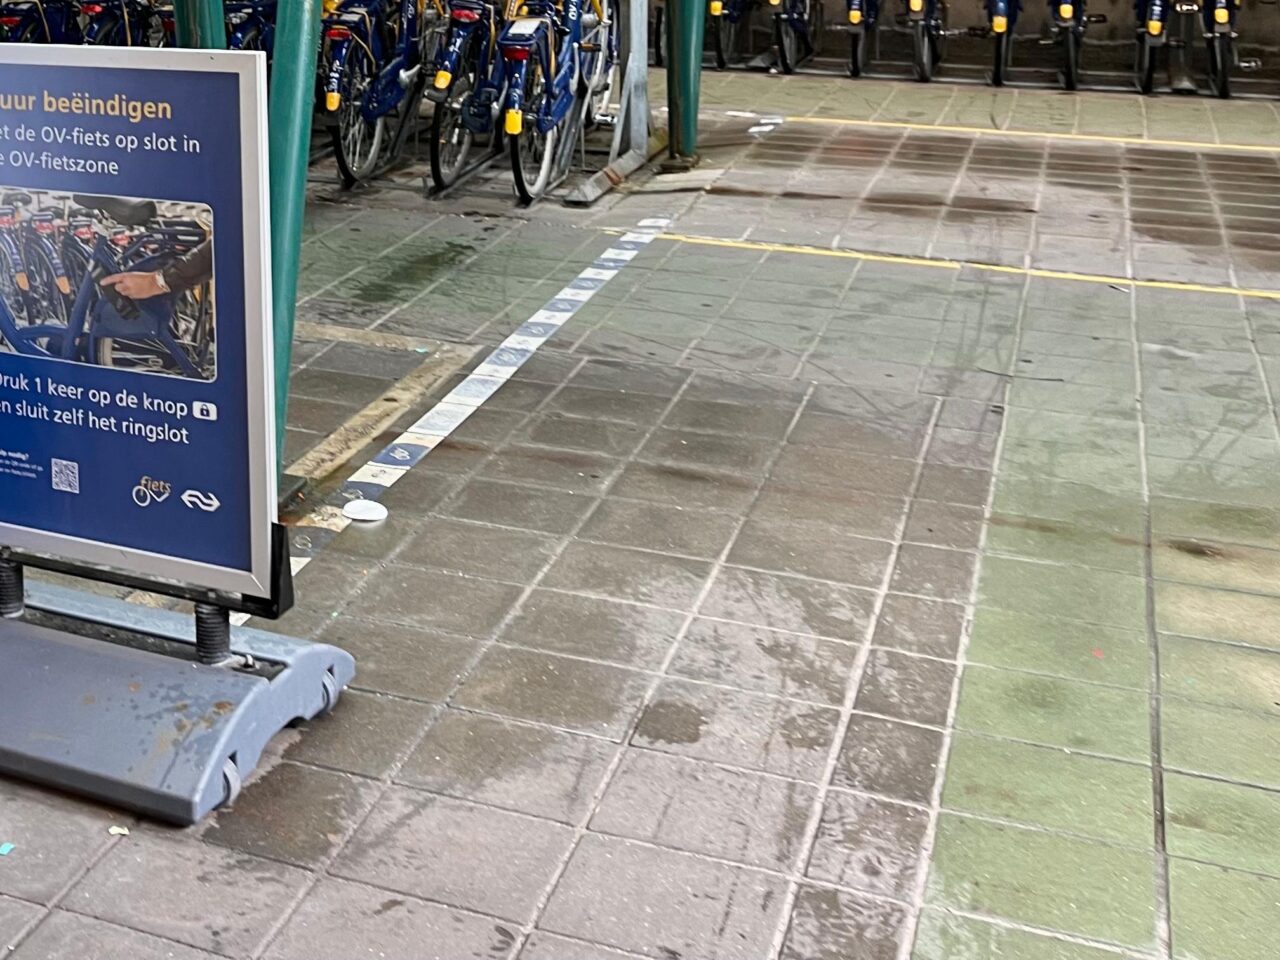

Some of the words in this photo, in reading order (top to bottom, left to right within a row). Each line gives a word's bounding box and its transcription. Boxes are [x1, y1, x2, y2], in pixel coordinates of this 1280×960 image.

[43, 91, 171, 123] beëindigen
[15, 124, 35, 142] de
[41, 126, 110, 148] OV-fiets
[115, 133, 138, 152] op
[143, 133, 177, 152] slot
[184, 136, 200, 153] in
[9, 149, 119, 175] OV-fietszone
[35, 377, 42, 394] 1
[48, 378, 83, 402] keer
[89, 385, 111, 407] op
[116, 389, 138, 408] de
[143, 392, 188, 417] knop
[16, 399, 50, 422] sluit
[54, 407, 84, 428] zelf
[89, 414, 117, 433] het
[121, 419, 189, 445] ringslot
[141, 475, 171, 496] fiets
